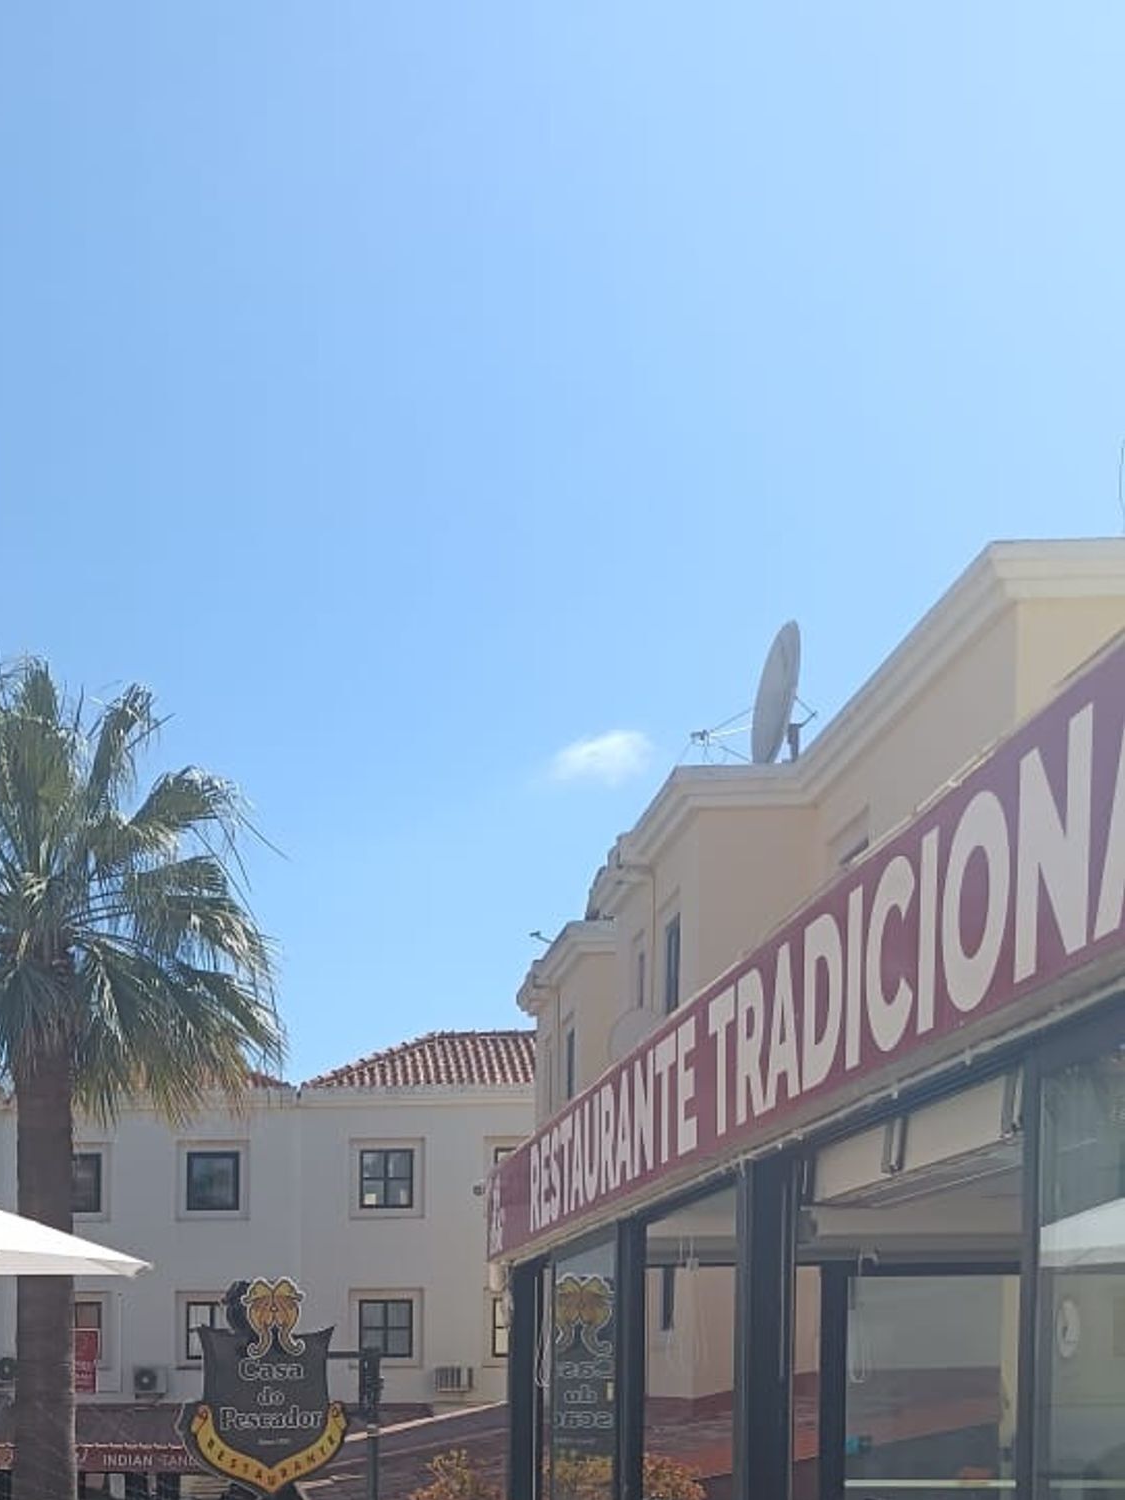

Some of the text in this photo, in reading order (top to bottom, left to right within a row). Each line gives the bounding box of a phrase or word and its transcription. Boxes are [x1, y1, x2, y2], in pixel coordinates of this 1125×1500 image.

[529, 1016, 699, 1233] RESTAURANTE
[238, 1357, 304, 1381] Casa
[257, 1385, 285, 1406] do
[219, 1405, 323, 1431] Pescador
[103, 1453, 154, 1467] INDIAN
